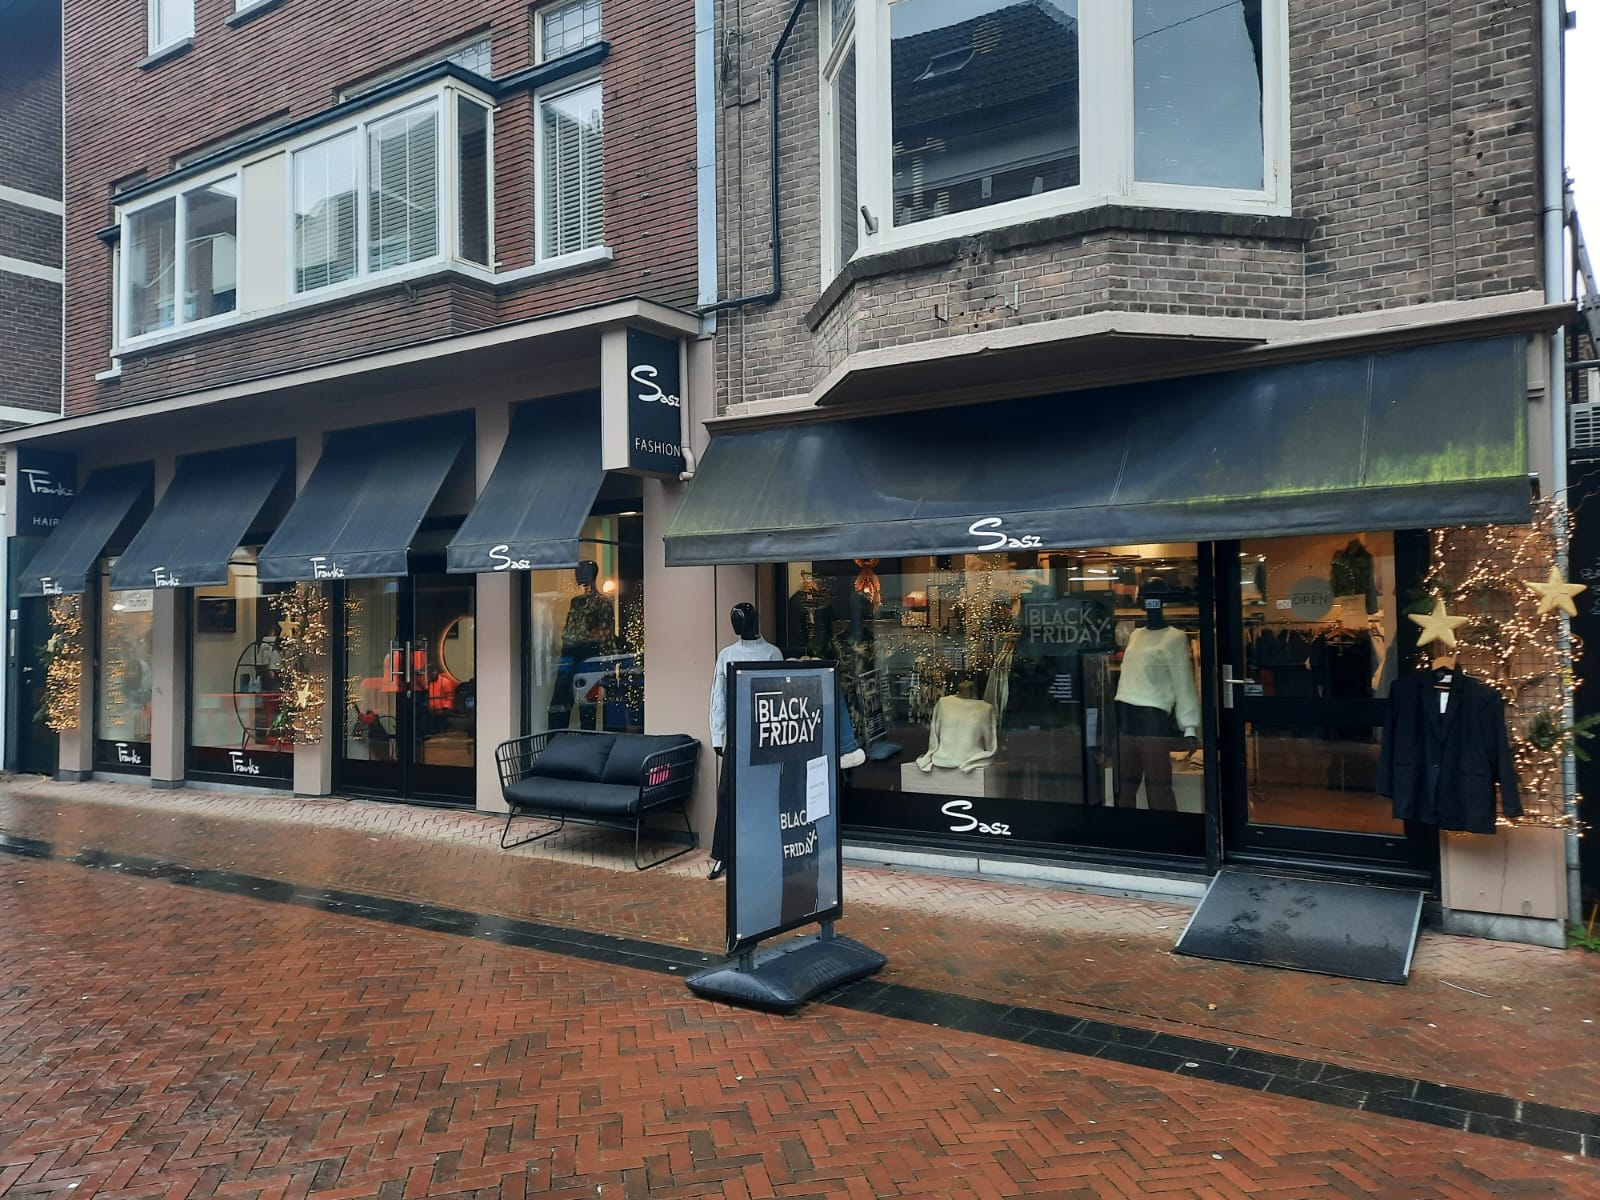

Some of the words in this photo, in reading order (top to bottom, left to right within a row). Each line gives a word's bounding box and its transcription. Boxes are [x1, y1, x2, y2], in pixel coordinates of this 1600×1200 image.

[630, 365, 680, 408] Sasz
[635, 437, 681, 458] FASHION
[20, 469, 74, 496] Frankz
[33, 517, 59, 526] HAIR
[968, 517, 1043, 551] Sasz
[310, 557, 345, 580] Frankz
[489, 545, 531, 571] Sasz
[152, 567, 180, 588] Frankz
[1293, 595, 1327, 605] OPEN
[1030, 607, 1093, 625] BLACK
[1030, 620, 1107, 645] FRIDAY
[759, 697, 808, 723] BLACK
[759, 711, 818, 748] FRIDAY
[115, 743, 141, 763] Frankz
[228, 752, 259, 775] Frankz
[780, 810, 815, 829] BLAC
[941, 800, 1012, 835] Sasz
[783, 831, 818, 859] FRIDAY
